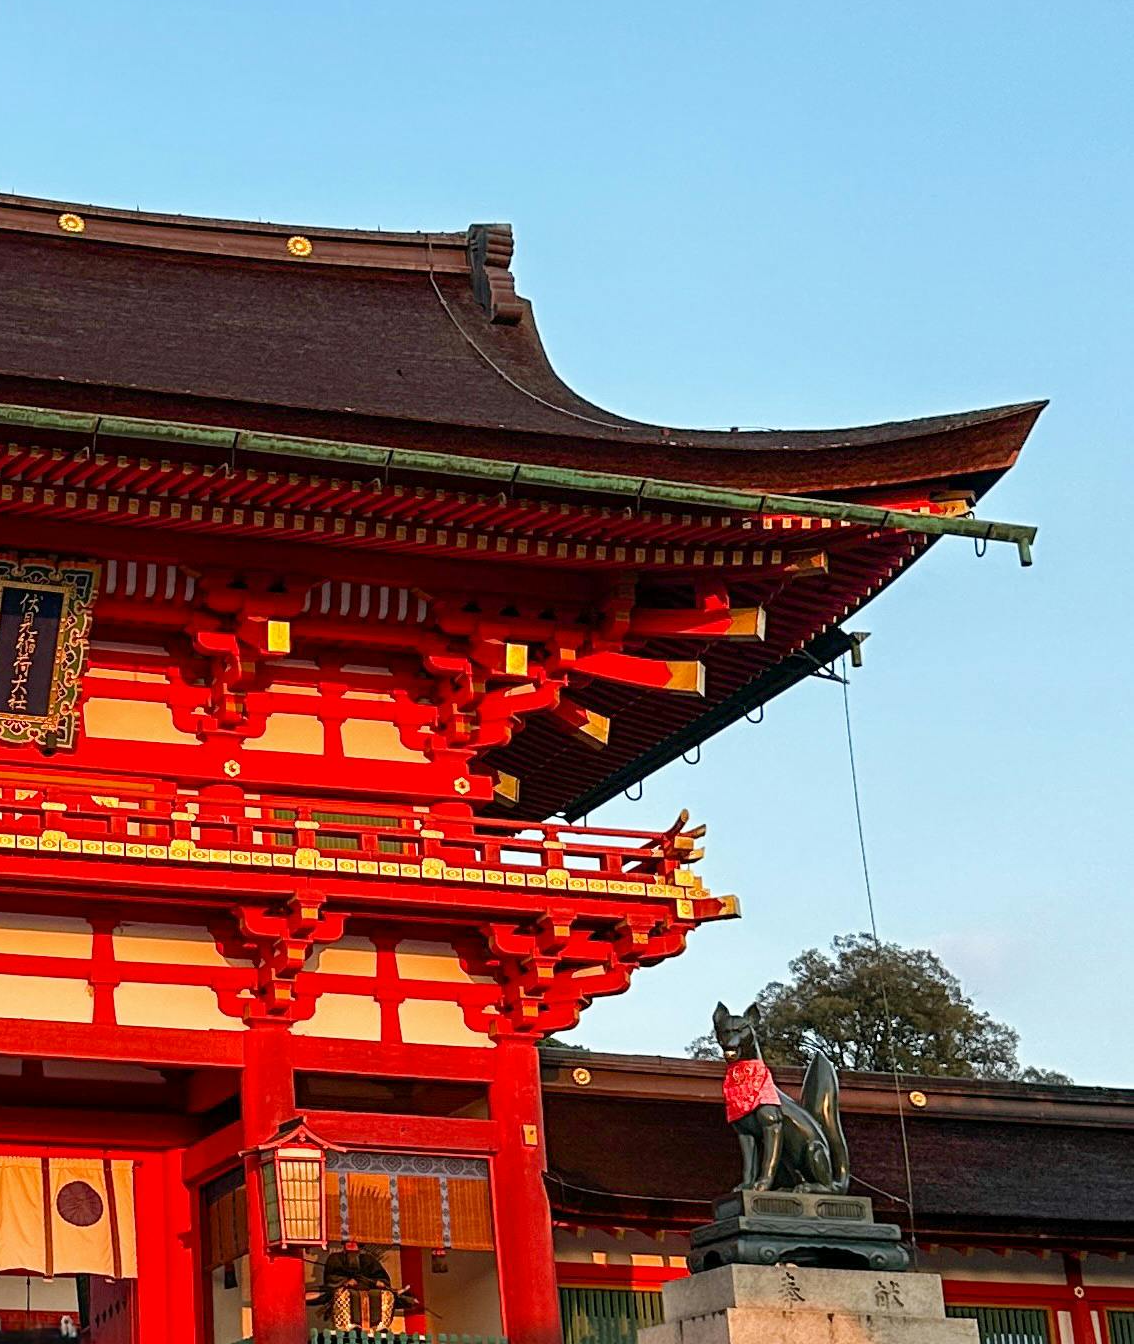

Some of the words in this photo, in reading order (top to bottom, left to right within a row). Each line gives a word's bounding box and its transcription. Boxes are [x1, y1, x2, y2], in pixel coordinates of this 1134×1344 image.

[7, 592, 44, 711] 伏見稲荷大社
